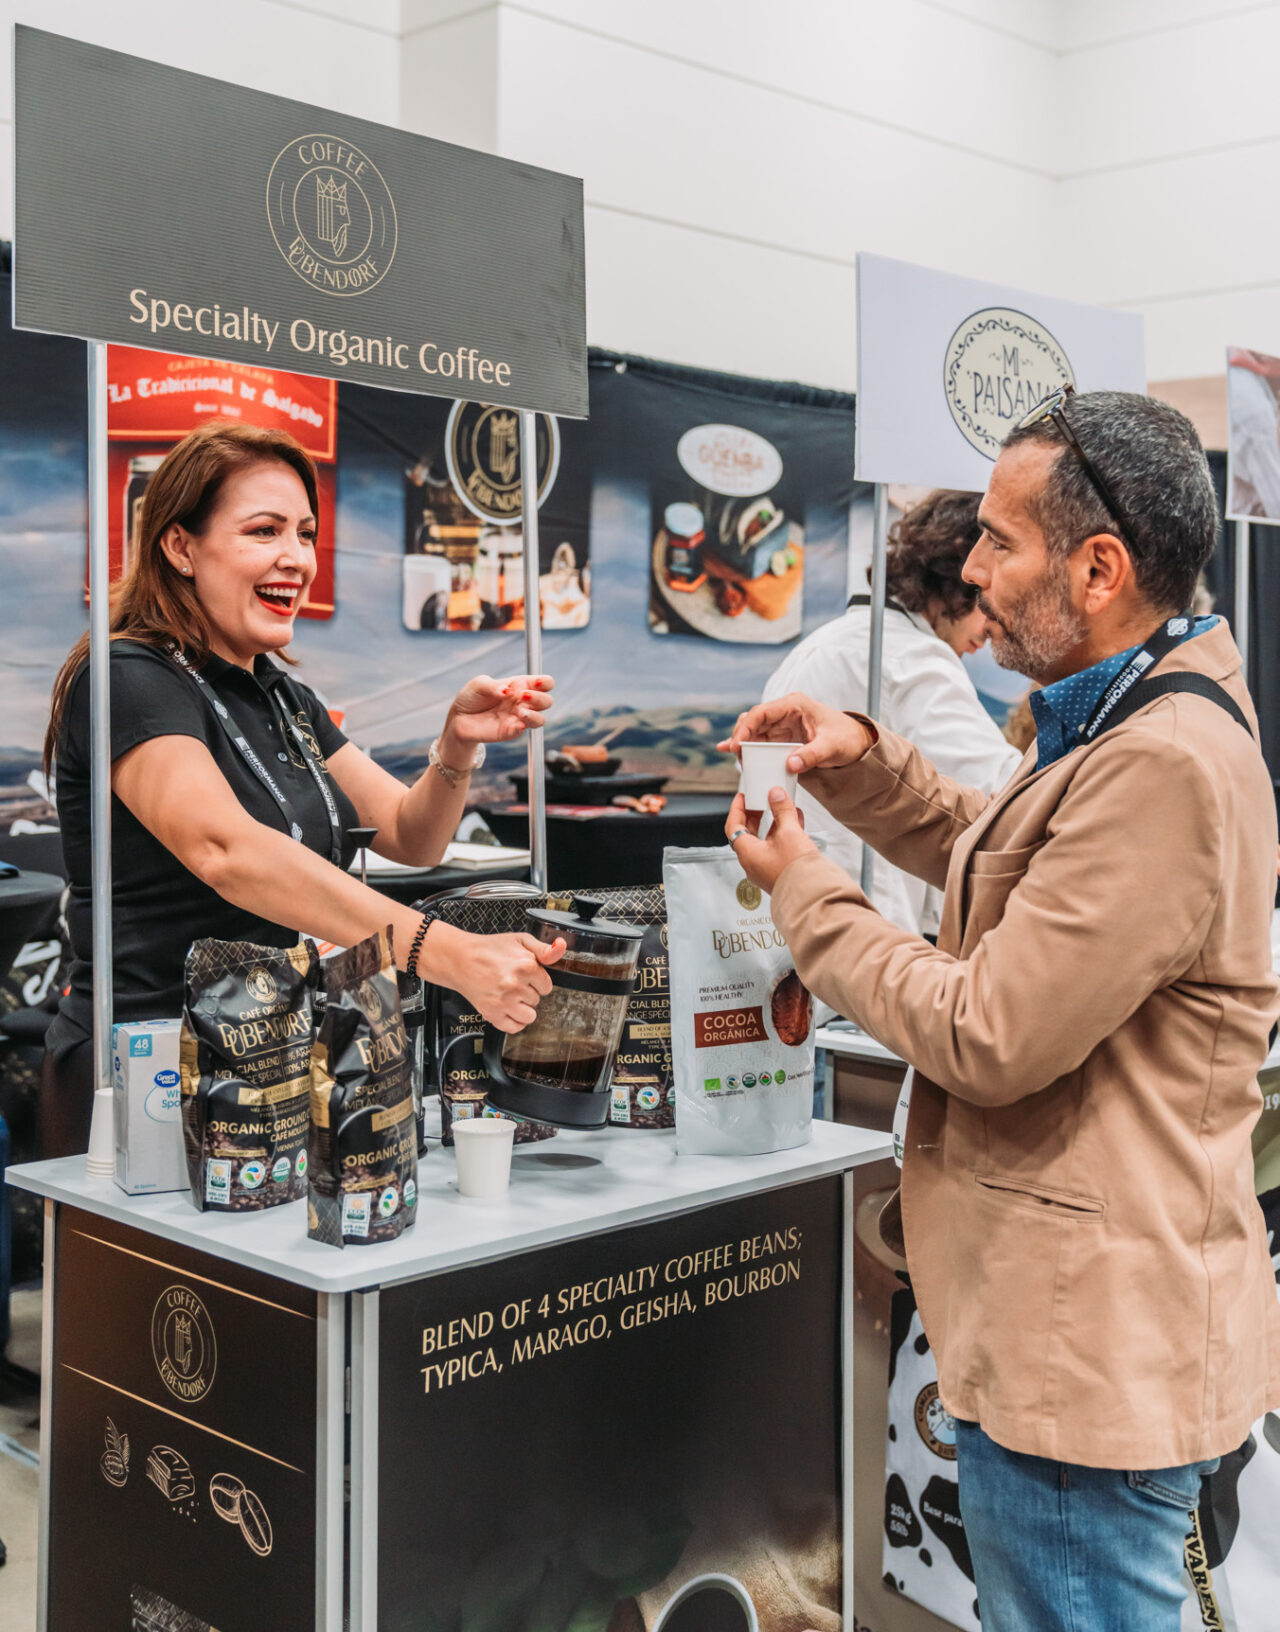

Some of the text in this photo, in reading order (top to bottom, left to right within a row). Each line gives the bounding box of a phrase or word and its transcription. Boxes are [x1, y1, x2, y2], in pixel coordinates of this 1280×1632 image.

[298, 141, 369, 180] COFFEE
[129, 289, 512, 387] Specialty Organic Coffee
[1002, 344, 1020, 376] MI
[107, 383, 132, 403] La
[240, 381, 257, 401] de
[262, 388, 323, 428] Salgado
[1086, 668, 1141, 738] PERFORMANCE
[246, 749, 287, 803] PERFORMANCE
[645, 955, 667, 965] CAFÉ
[729, 981, 755, 991] QUALITY
[239, 1006, 261, 1021] CAFÉ
[703, 1012, 757, 1030] COCOA
[134, 1038, 149, 1049] 48
[703, 1027, 760, 1042] ORGÁNICA
[617, 1053, 661, 1064] RGANIC
[156, 1073, 176, 1082] Great
[210, 1120, 272, 1135] ORGANIC
[344, 1143, 398, 1168] ORGANIC
[421, 1226, 804, 1356] BLEND OF 4 SPECIALTY COFFEE BEANS;
[166, 1290, 202, 1320] COFFEE
[420, 1257, 802, 1394] TYPICA, MARAGO, GEISHA, BOURBON
[944, 1512, 963, 1527] para
